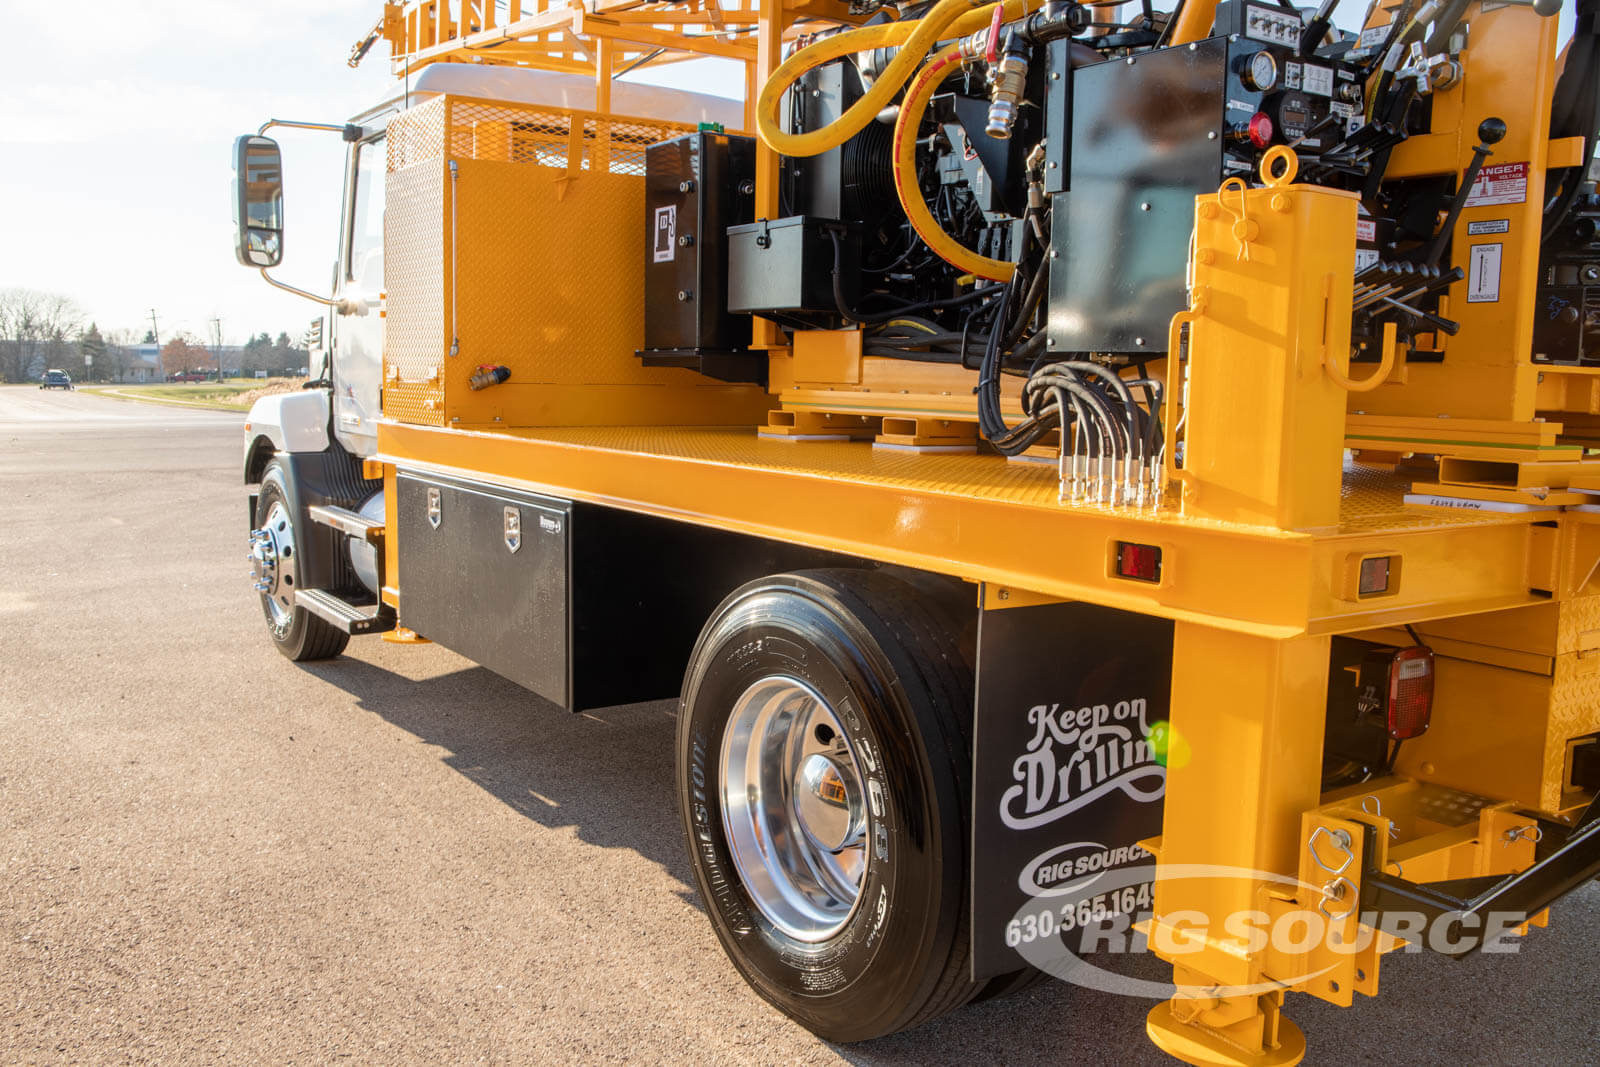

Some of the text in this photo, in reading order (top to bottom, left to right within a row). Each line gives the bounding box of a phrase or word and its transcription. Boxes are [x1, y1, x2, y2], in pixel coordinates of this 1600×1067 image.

[1477, 164, 1524, 176] ANGER
[1027, 698, 1154, 753] Keep on
[1037, 860, 1074, 885] RIG
[1005, 881, 1155, 948] 630.365.164
